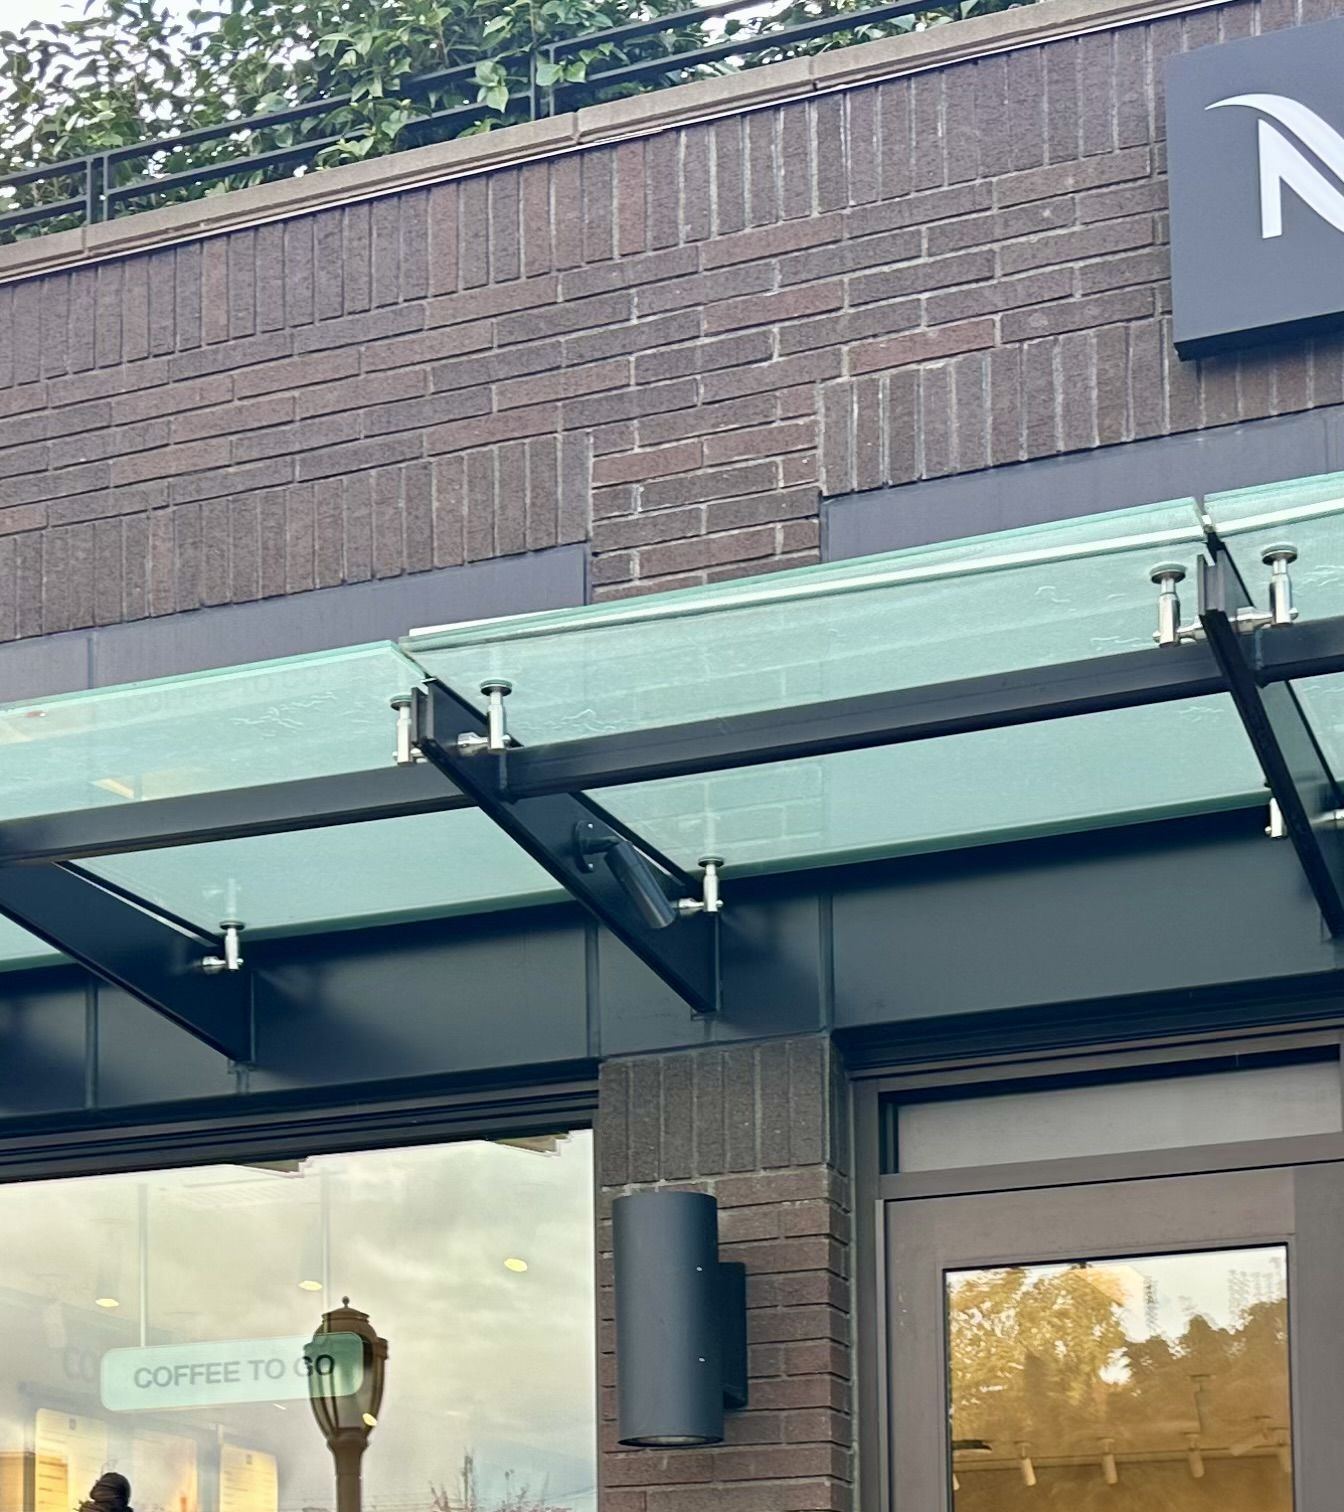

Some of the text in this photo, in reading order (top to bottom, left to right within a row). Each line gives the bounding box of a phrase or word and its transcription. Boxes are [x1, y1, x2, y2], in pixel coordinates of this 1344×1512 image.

[134, 1354, 335, 1388] COFFEE TO GO
